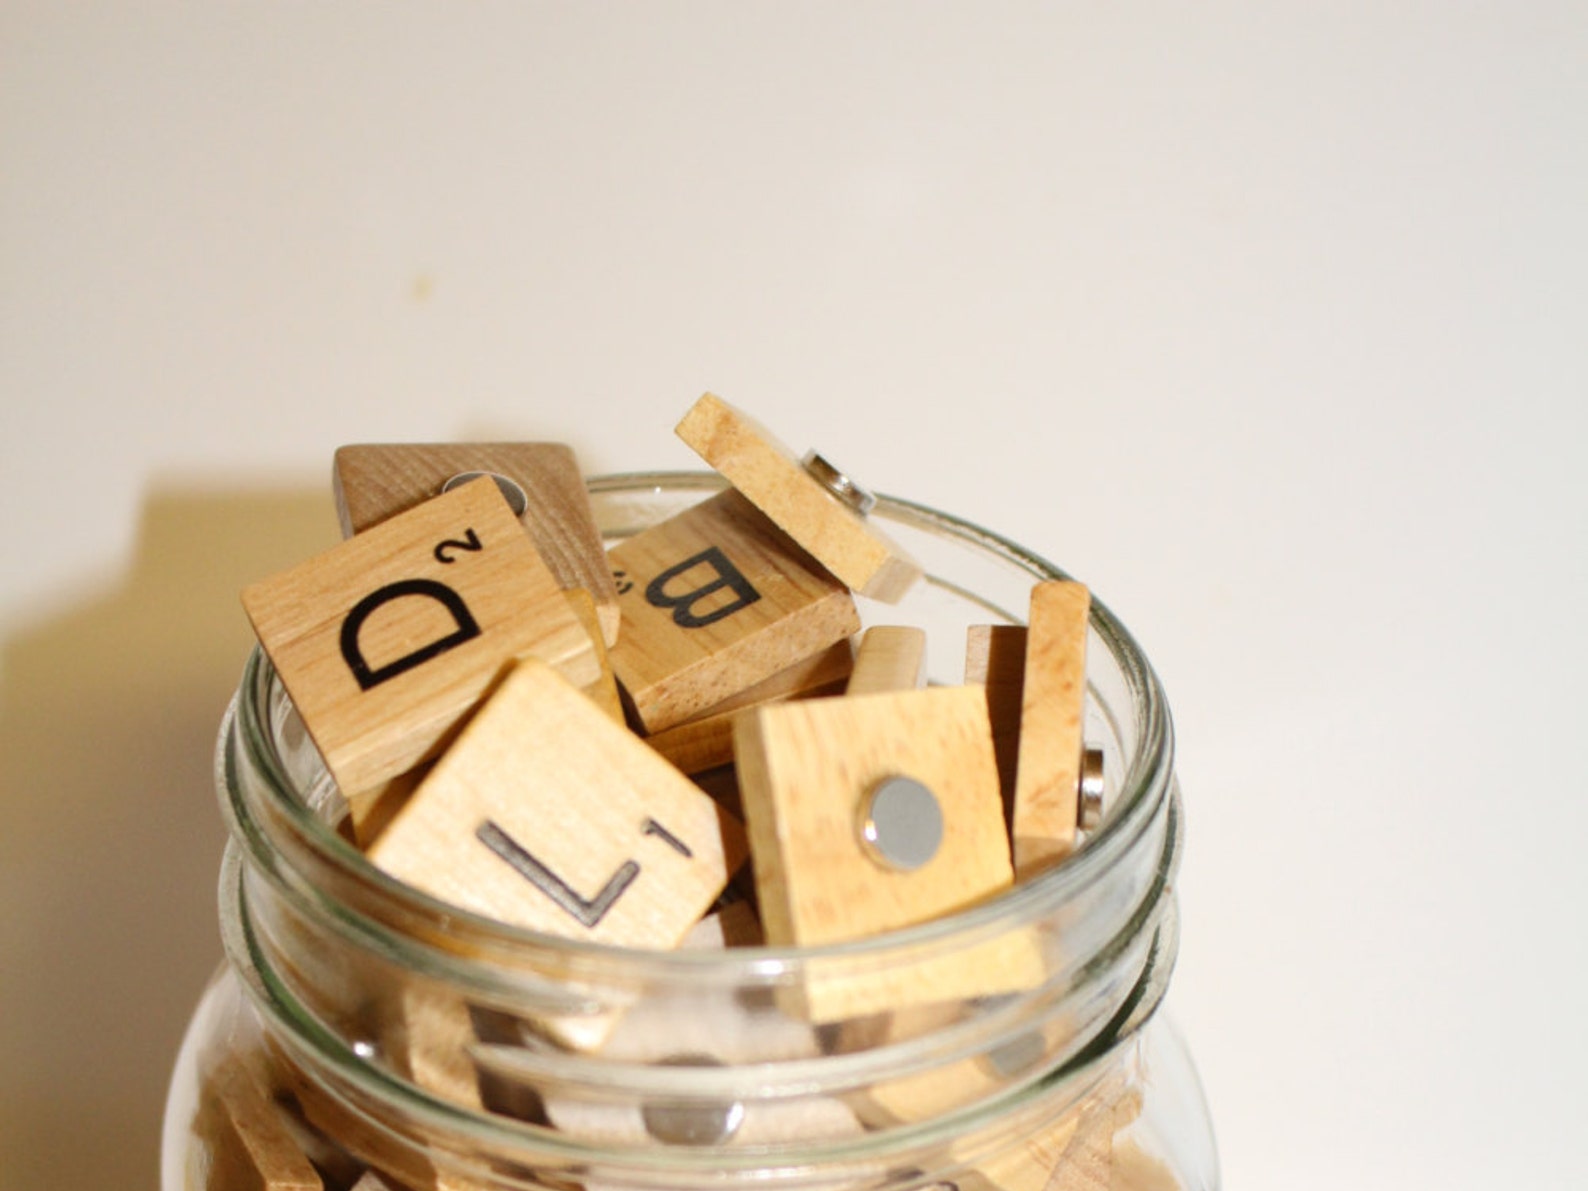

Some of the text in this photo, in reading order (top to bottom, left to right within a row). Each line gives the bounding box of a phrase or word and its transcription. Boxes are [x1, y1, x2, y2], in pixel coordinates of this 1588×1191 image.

[340, 527, 483, 692] D 2
[645, 546, 762, 628] B
[475, 817, 694, 928] L 1
